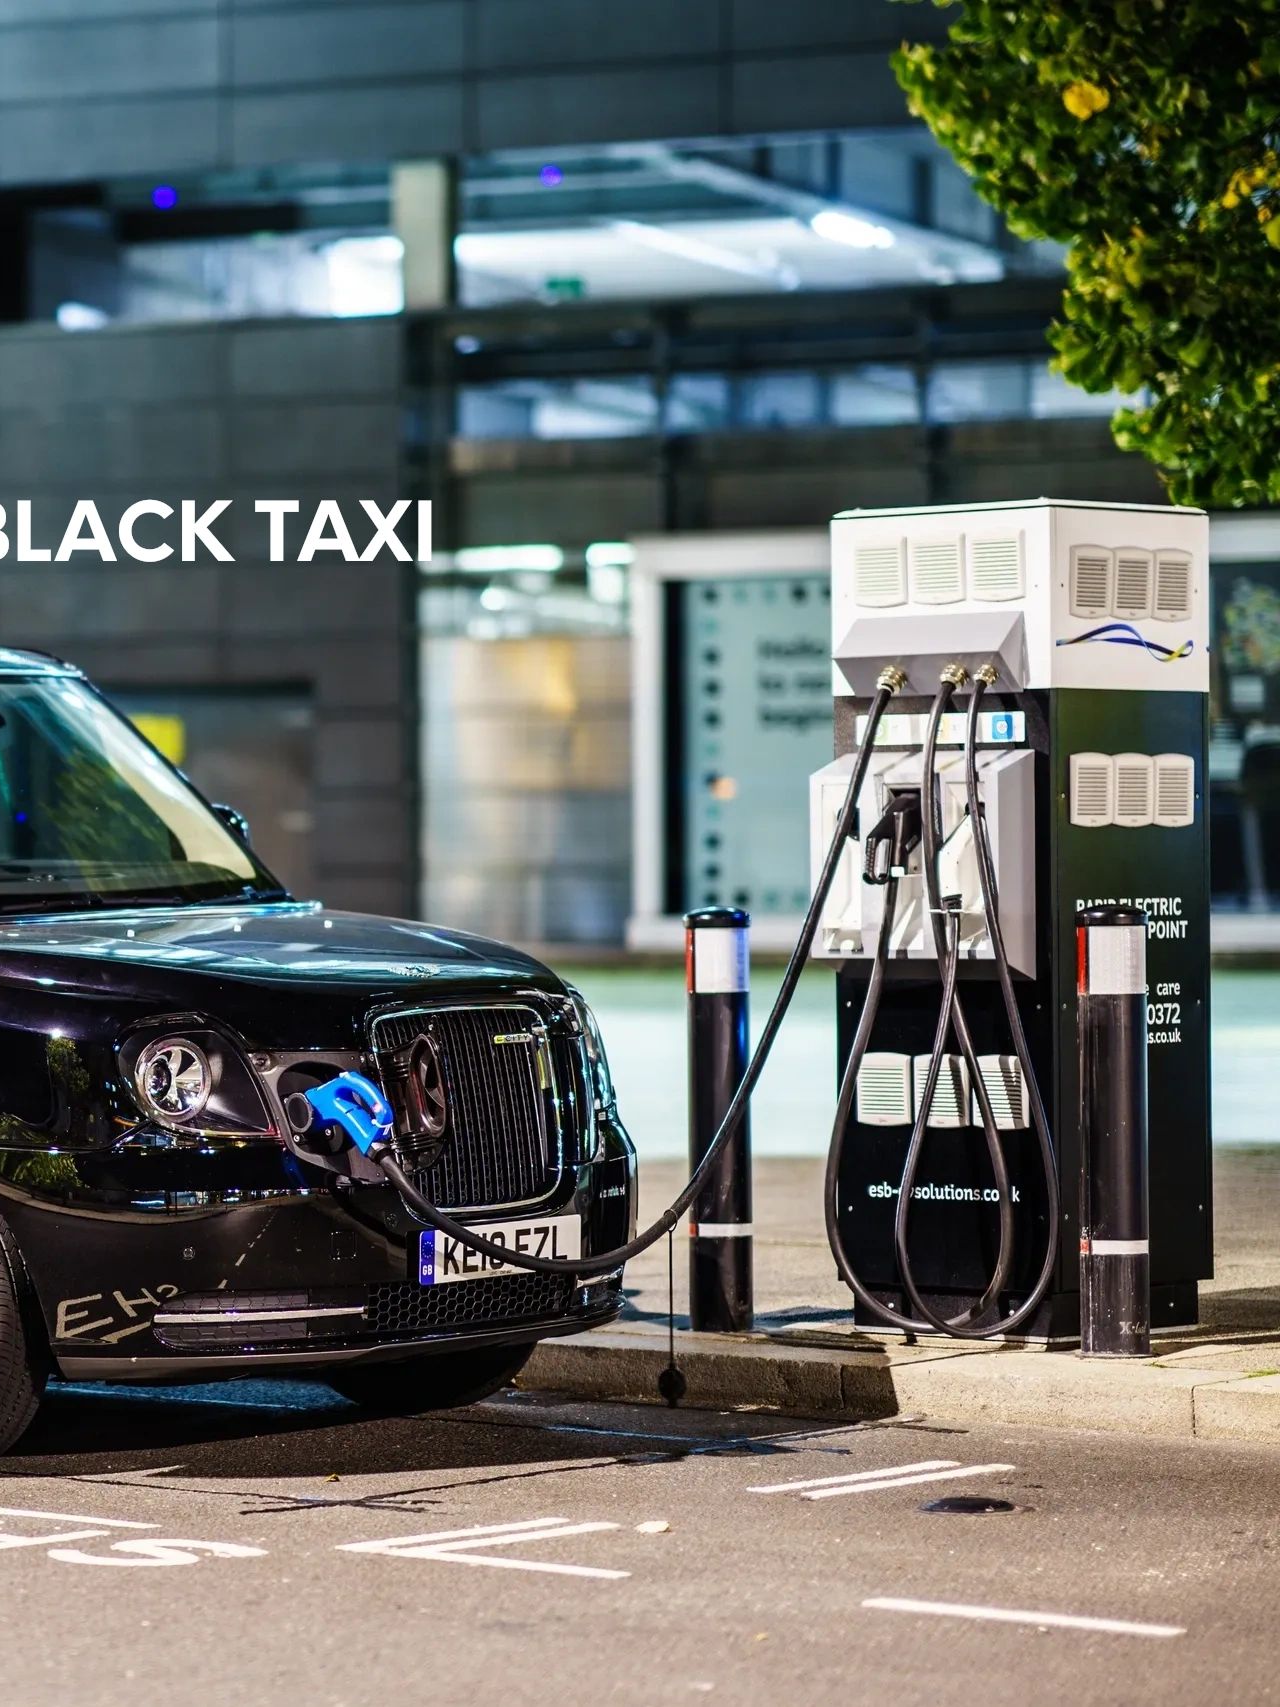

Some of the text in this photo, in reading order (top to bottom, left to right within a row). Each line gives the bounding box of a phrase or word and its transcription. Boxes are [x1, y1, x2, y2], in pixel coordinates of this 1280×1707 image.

[1148, 920, 1188, 939] POINT
[1156, 982, 1181, 996] care
[868, 1181, 1020, 1203] esb-solutions.cok
[422, 1264, 433, 1276] GB
